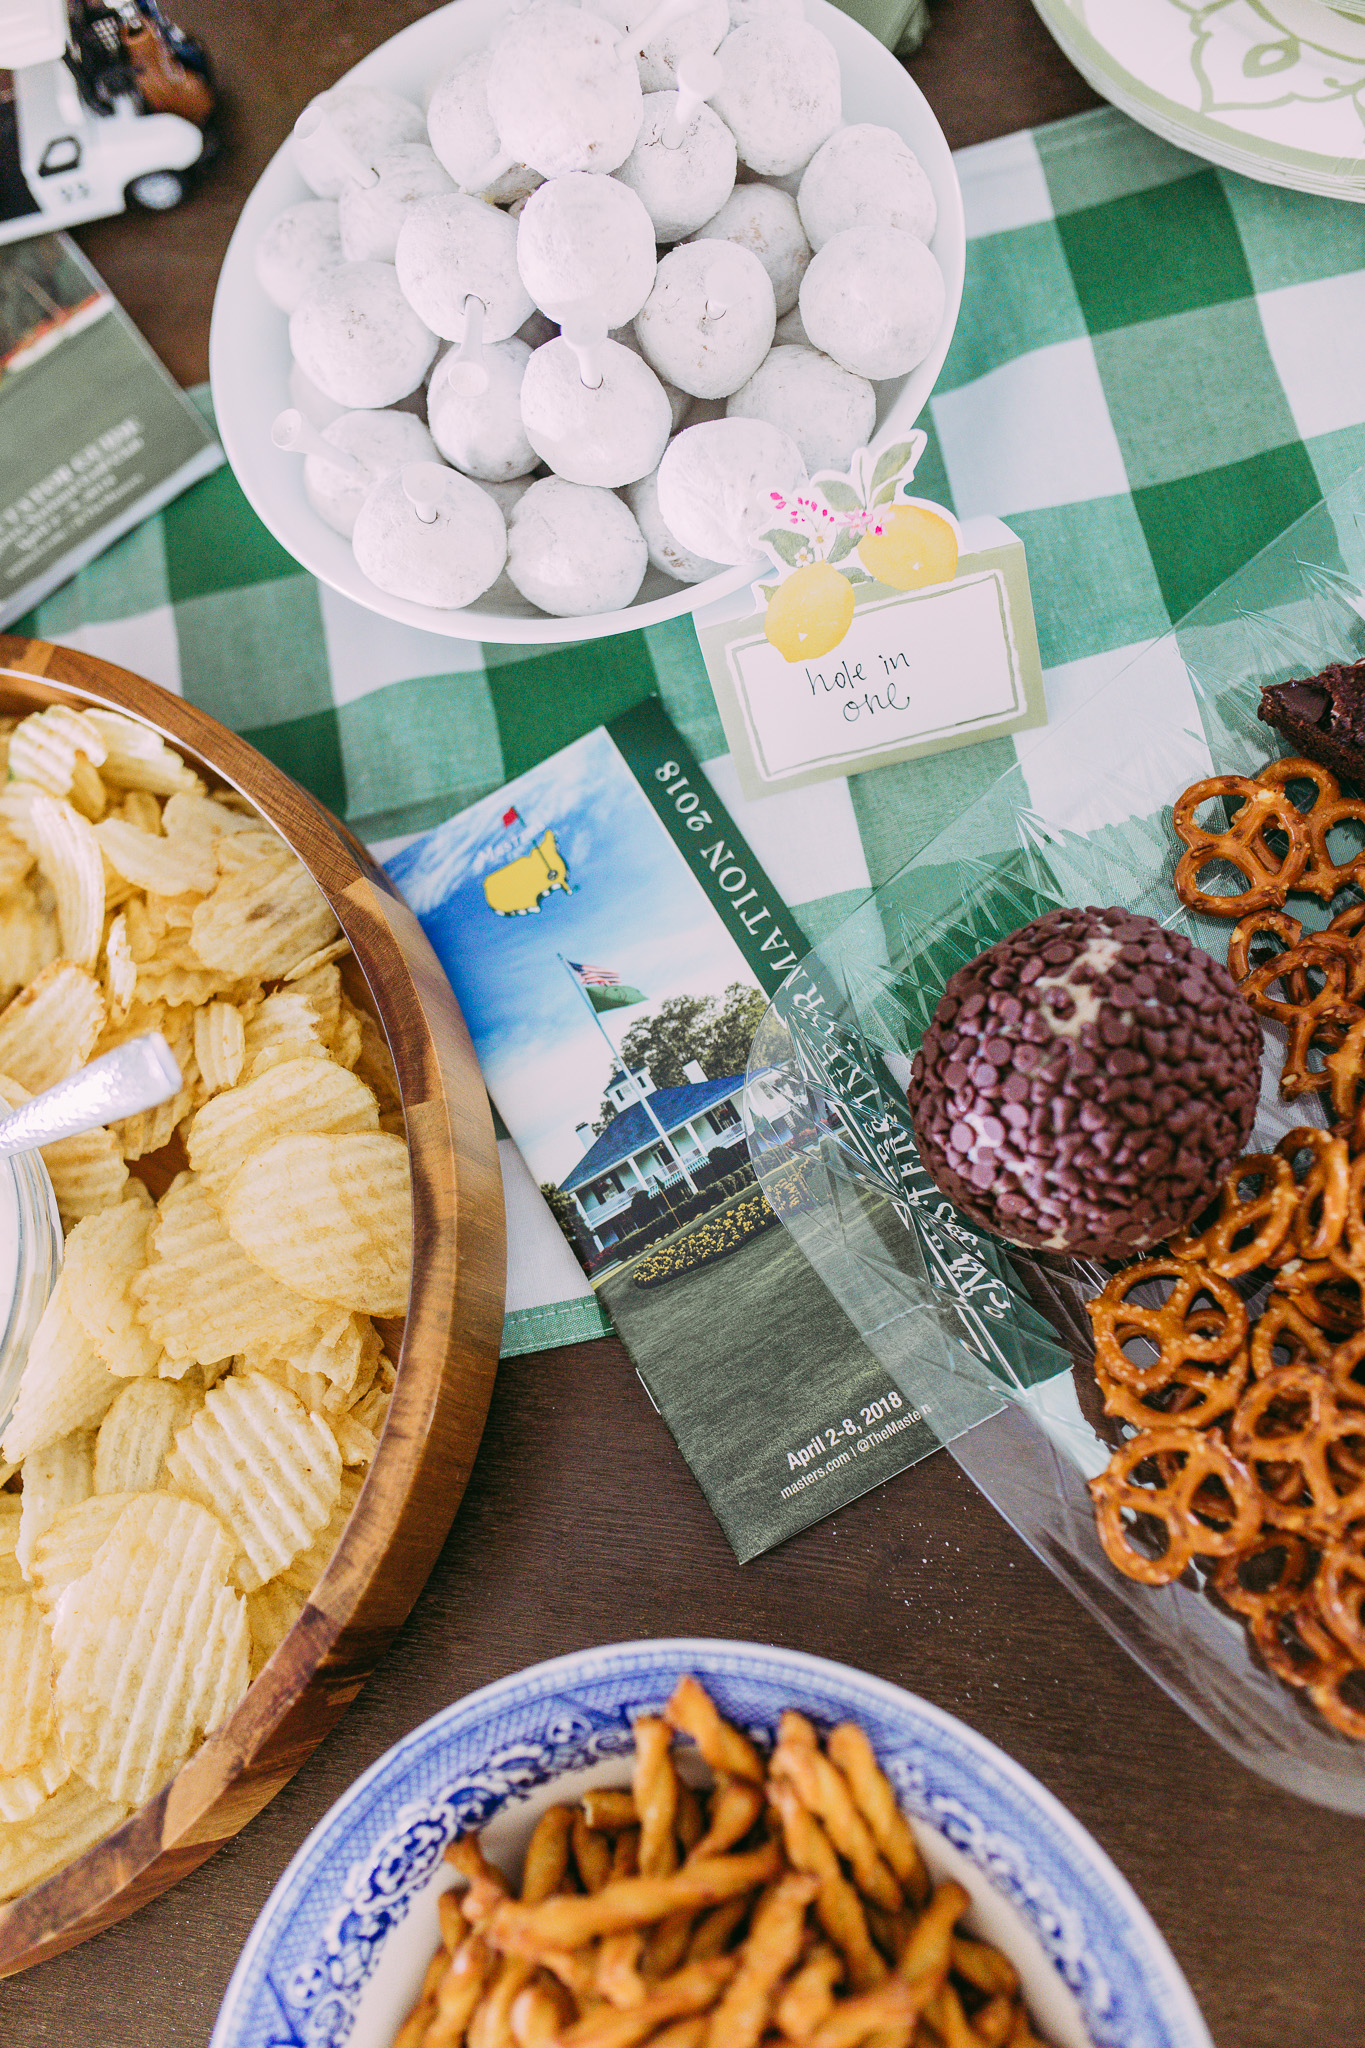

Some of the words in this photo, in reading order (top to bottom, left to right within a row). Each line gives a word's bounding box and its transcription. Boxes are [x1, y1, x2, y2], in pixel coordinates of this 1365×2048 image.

[805, 660, 867, 695] hole
[878, 653, 911, 675] in
[843, 682, 911, 722] one
[655, 760, 713, 832] 2018
[780, 1451, 851, 1499] masters.com
[856, 1404, 932, 1453] @TheMasters
[786, 1436, 827, 1470] April
[825, 1418, 863, 1447] 2-8,
[860, 1391, 903, 1426] 2018
